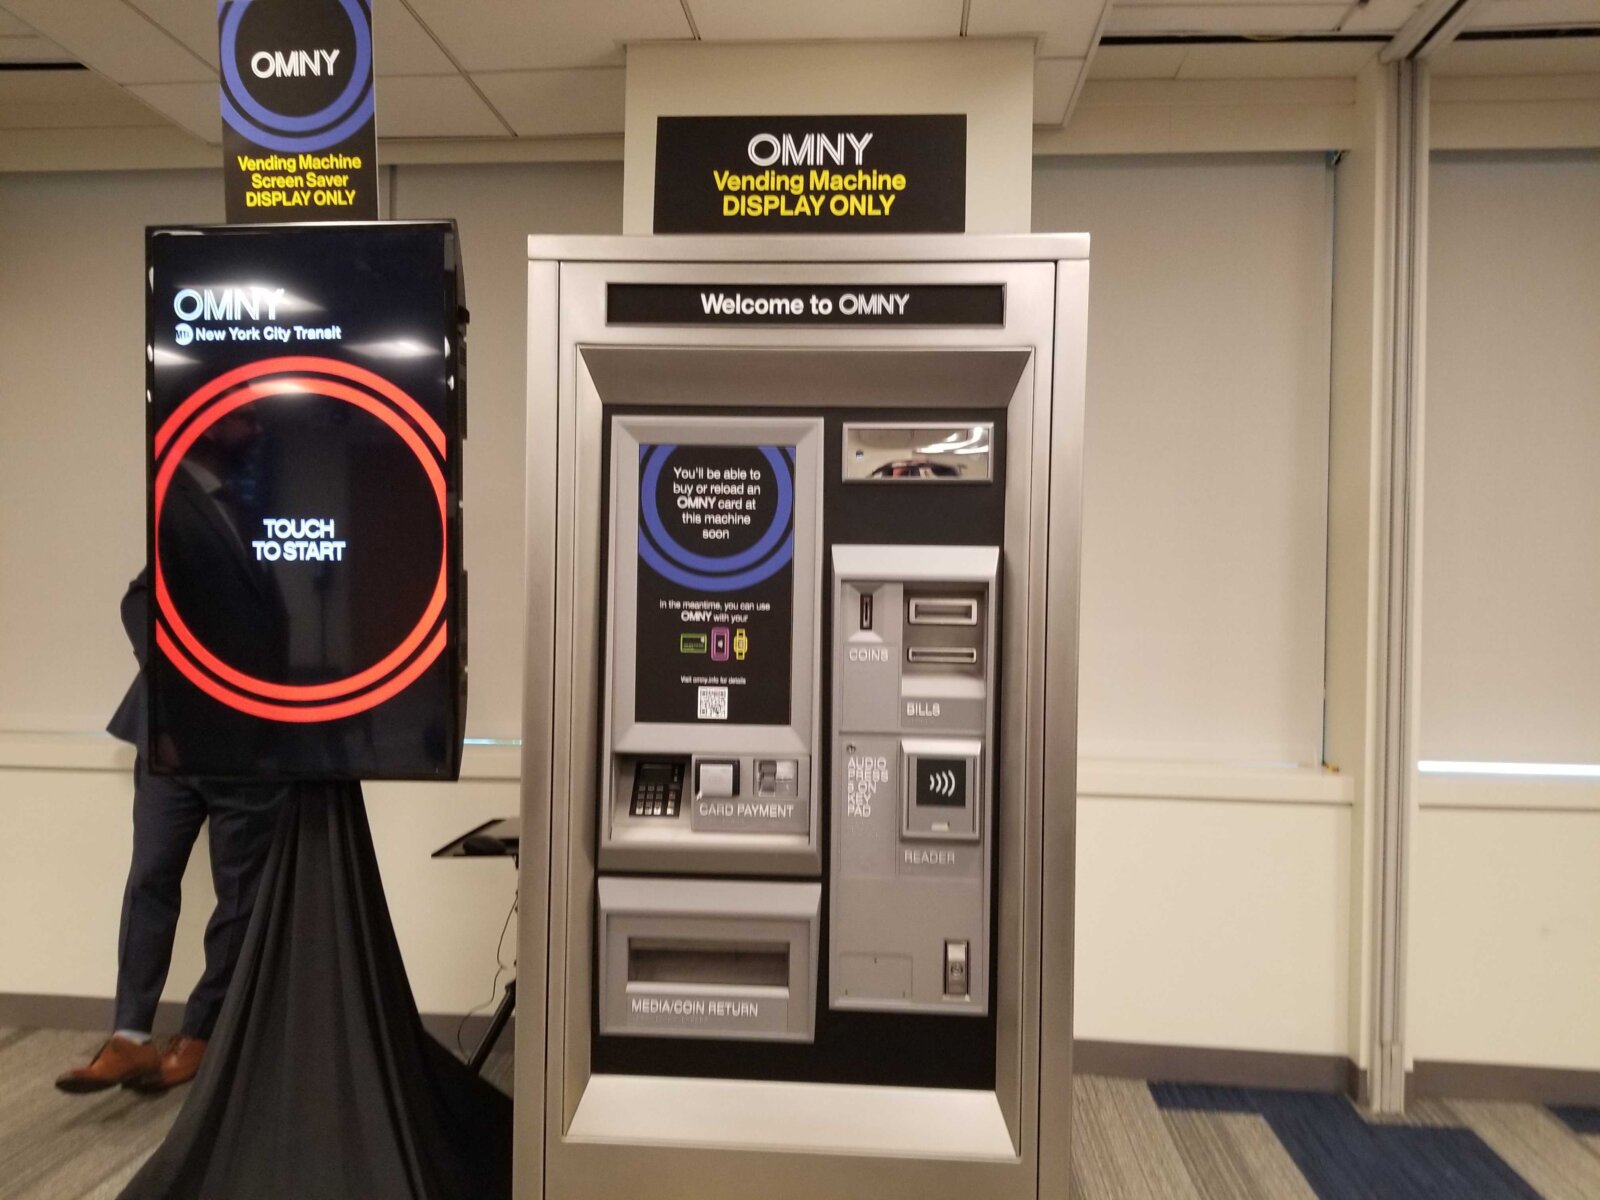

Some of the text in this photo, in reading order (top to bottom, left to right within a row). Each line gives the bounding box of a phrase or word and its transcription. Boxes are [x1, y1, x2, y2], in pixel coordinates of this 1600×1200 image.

[251, 49, 340, 78] OMNY
[748, 132, 873, 166] OMNY
[237, 153, 362, 172] Vending Machine
[252, 172, 348, 188] Screen Saver
[713, 170, 906, 194] Vending Machine
[246, 190, 356, 207] DISPLAY ONLY
[723, 195, 895, 216] DISPLAY ONLY
[174, 288, 284, 321] OMNY
[701, 293, 909, 315] Welcome to OMNY
[196, 327, 226, 340] New
[228, 327, 260, 340] York
[264, 326, 290, 343] City
[294, 326, 342, 340] Transit
[673, 467, 760, 481] You'll be able to
[673, 483, 761, 497] buy or reload an
[677, 496, 756, 510] OMNY card at
[682, 512, 751, 525] this machine
[263, 518, 334, 538] TOUCH
[702, 529, 729, 540] soon
[252, 541, 346, 561] TO START
[660, 600, 770, 613] In the meantime, you can use
[681, 611, 748, 625] OMNY with your
[849, 648, 889, 662] COINS
[906, 703, 940, 716] BILLS
[848, 757, 887, 770] AUDIO
[858, 781, 876, 794] ON
[848, 793, 871, 806] KEY
[699, 804, 794, 818] CARD PAYMENT
[848, 805, 871, 817] PAD
[904, 850, 955, 865] READER
[631, 1000, 758, 1016] MEDIA/COIN RETURN
